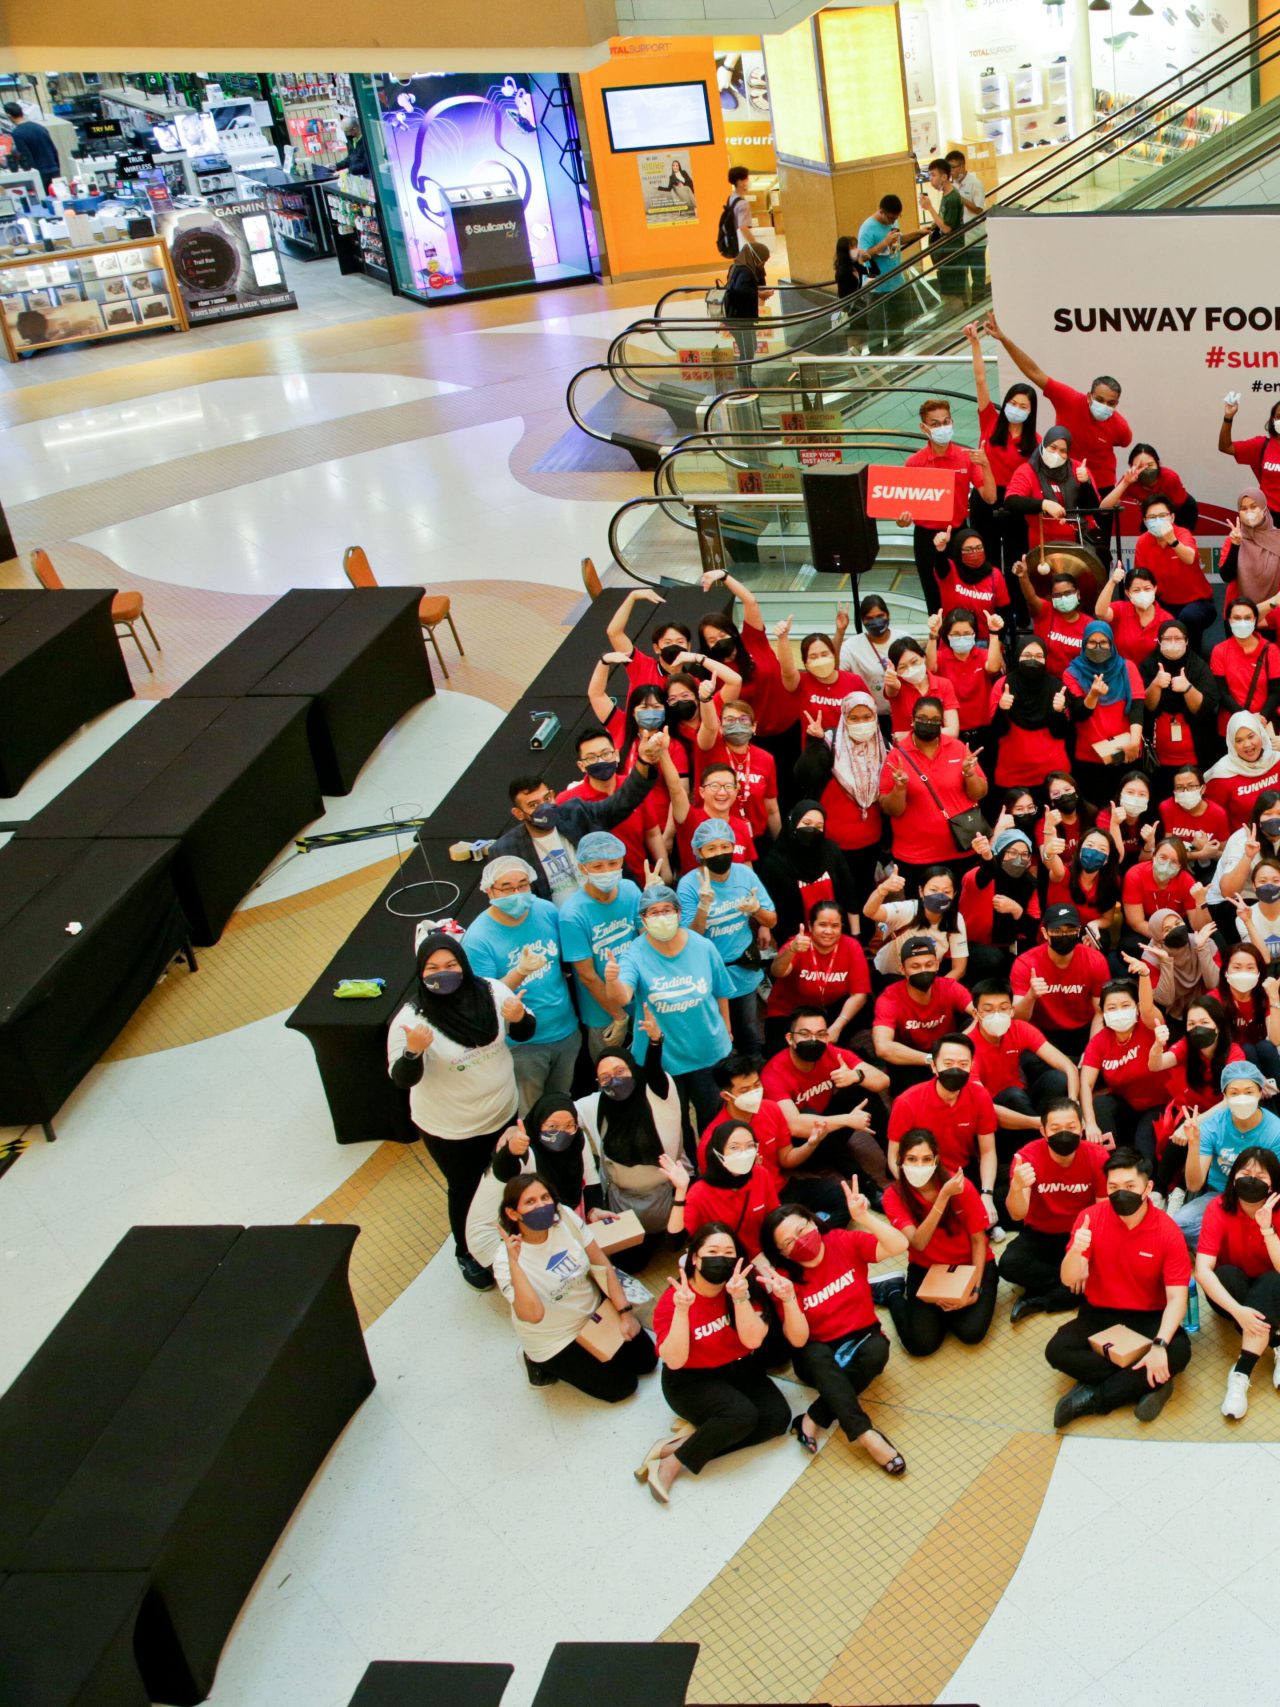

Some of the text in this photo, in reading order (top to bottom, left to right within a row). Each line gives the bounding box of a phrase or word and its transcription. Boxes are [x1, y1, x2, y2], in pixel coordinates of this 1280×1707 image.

[128, 155, 144, 163] TRUE
[124, 164, 153, 173] WIRELESS
[215, 202, 265, 217] GARMIN
[473, 221, 516, 234] Skullcandy
[1053, 307, 1197, 332] SUNWAY
[871, 485, 951, 502] SUNWAY
[955, 583, 993, 601] SUNWAY
[810, 694, 842, 706] SUNW
[1237, 773, 1279, 796] SUNWAY
[592, 917, 628, 940] Ending
[709, 918, 745, 938] Hunger
[521, 961, 554, 986] unger
[650, 974, 693, 991] Ending
[1046, 983, 1085, 994] UNWAY
[655, 997, 702, 1014] Hunger
[1038, 1182, 1091, 1194] SUNWAY
[803, 1269, 855, 1311] SUNWAY
[694, 1314, 731, 1341] SUNW
